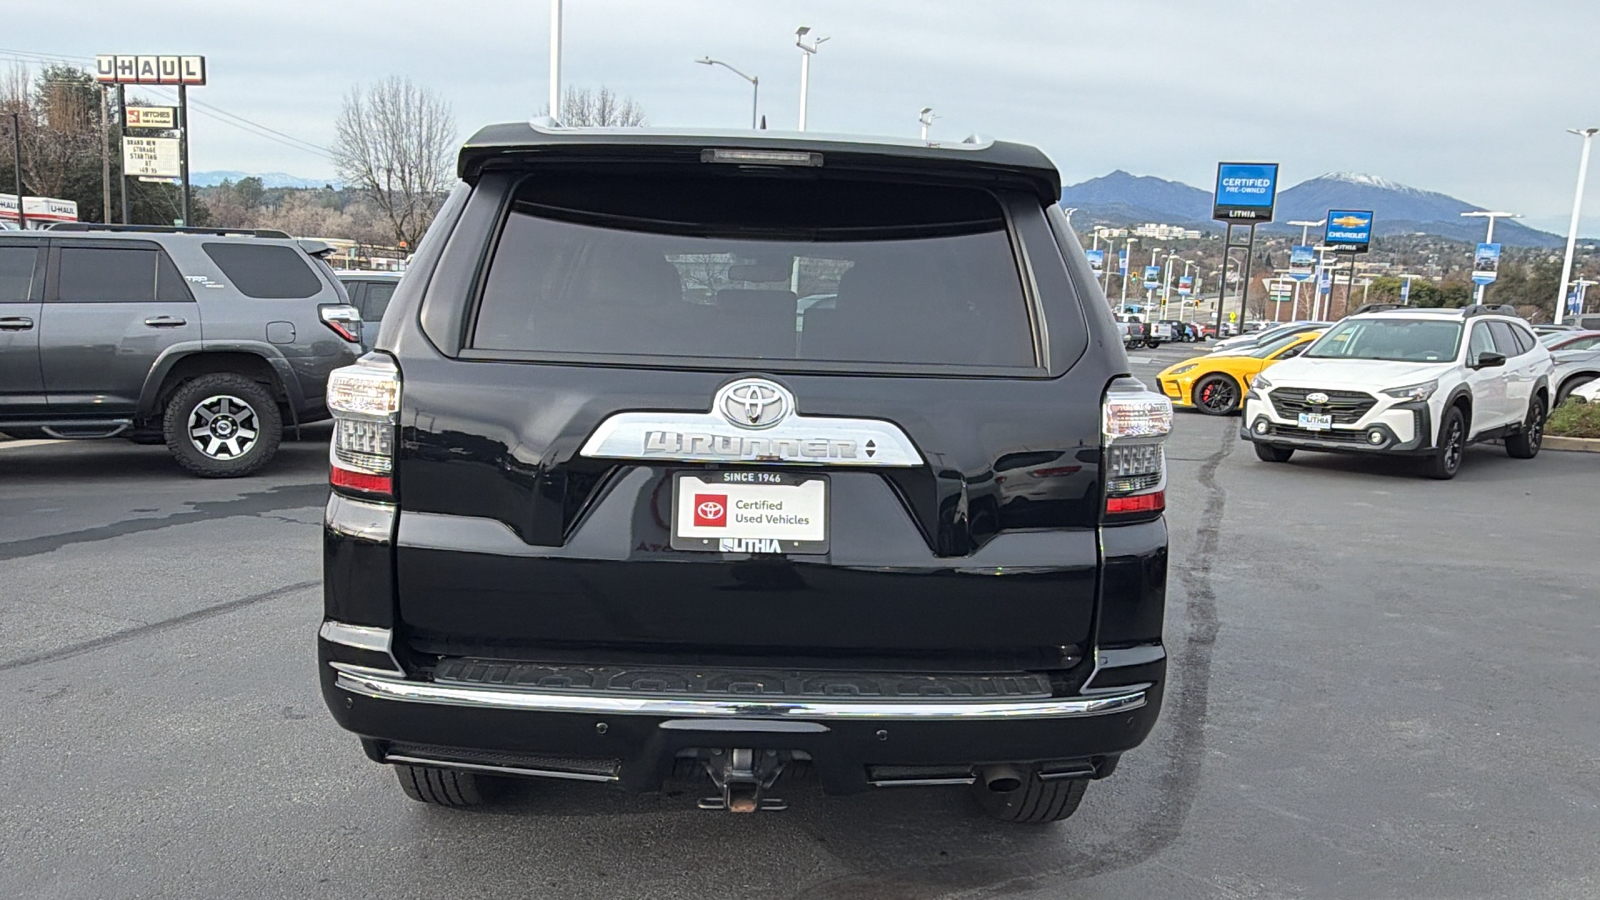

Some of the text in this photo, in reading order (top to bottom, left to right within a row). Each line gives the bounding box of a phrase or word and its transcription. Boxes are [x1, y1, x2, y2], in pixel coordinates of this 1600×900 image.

[97, 60, 197, 76] U-HAUL
[1222, 178, 1271, 187] CERTIFIED
[50, 205, 75, 215] U-HAUL
[1229, 210, 1256, 218] LITHIA
[1328, 231, 1368, 239] CHEVROLET
[723, 472, 781, 483] SINCE 1946
[735, 499, 783, 511] Certified
[735, 513, 809, 525] Used Vehicles
[733, 538, 782, 554] LITHIA
